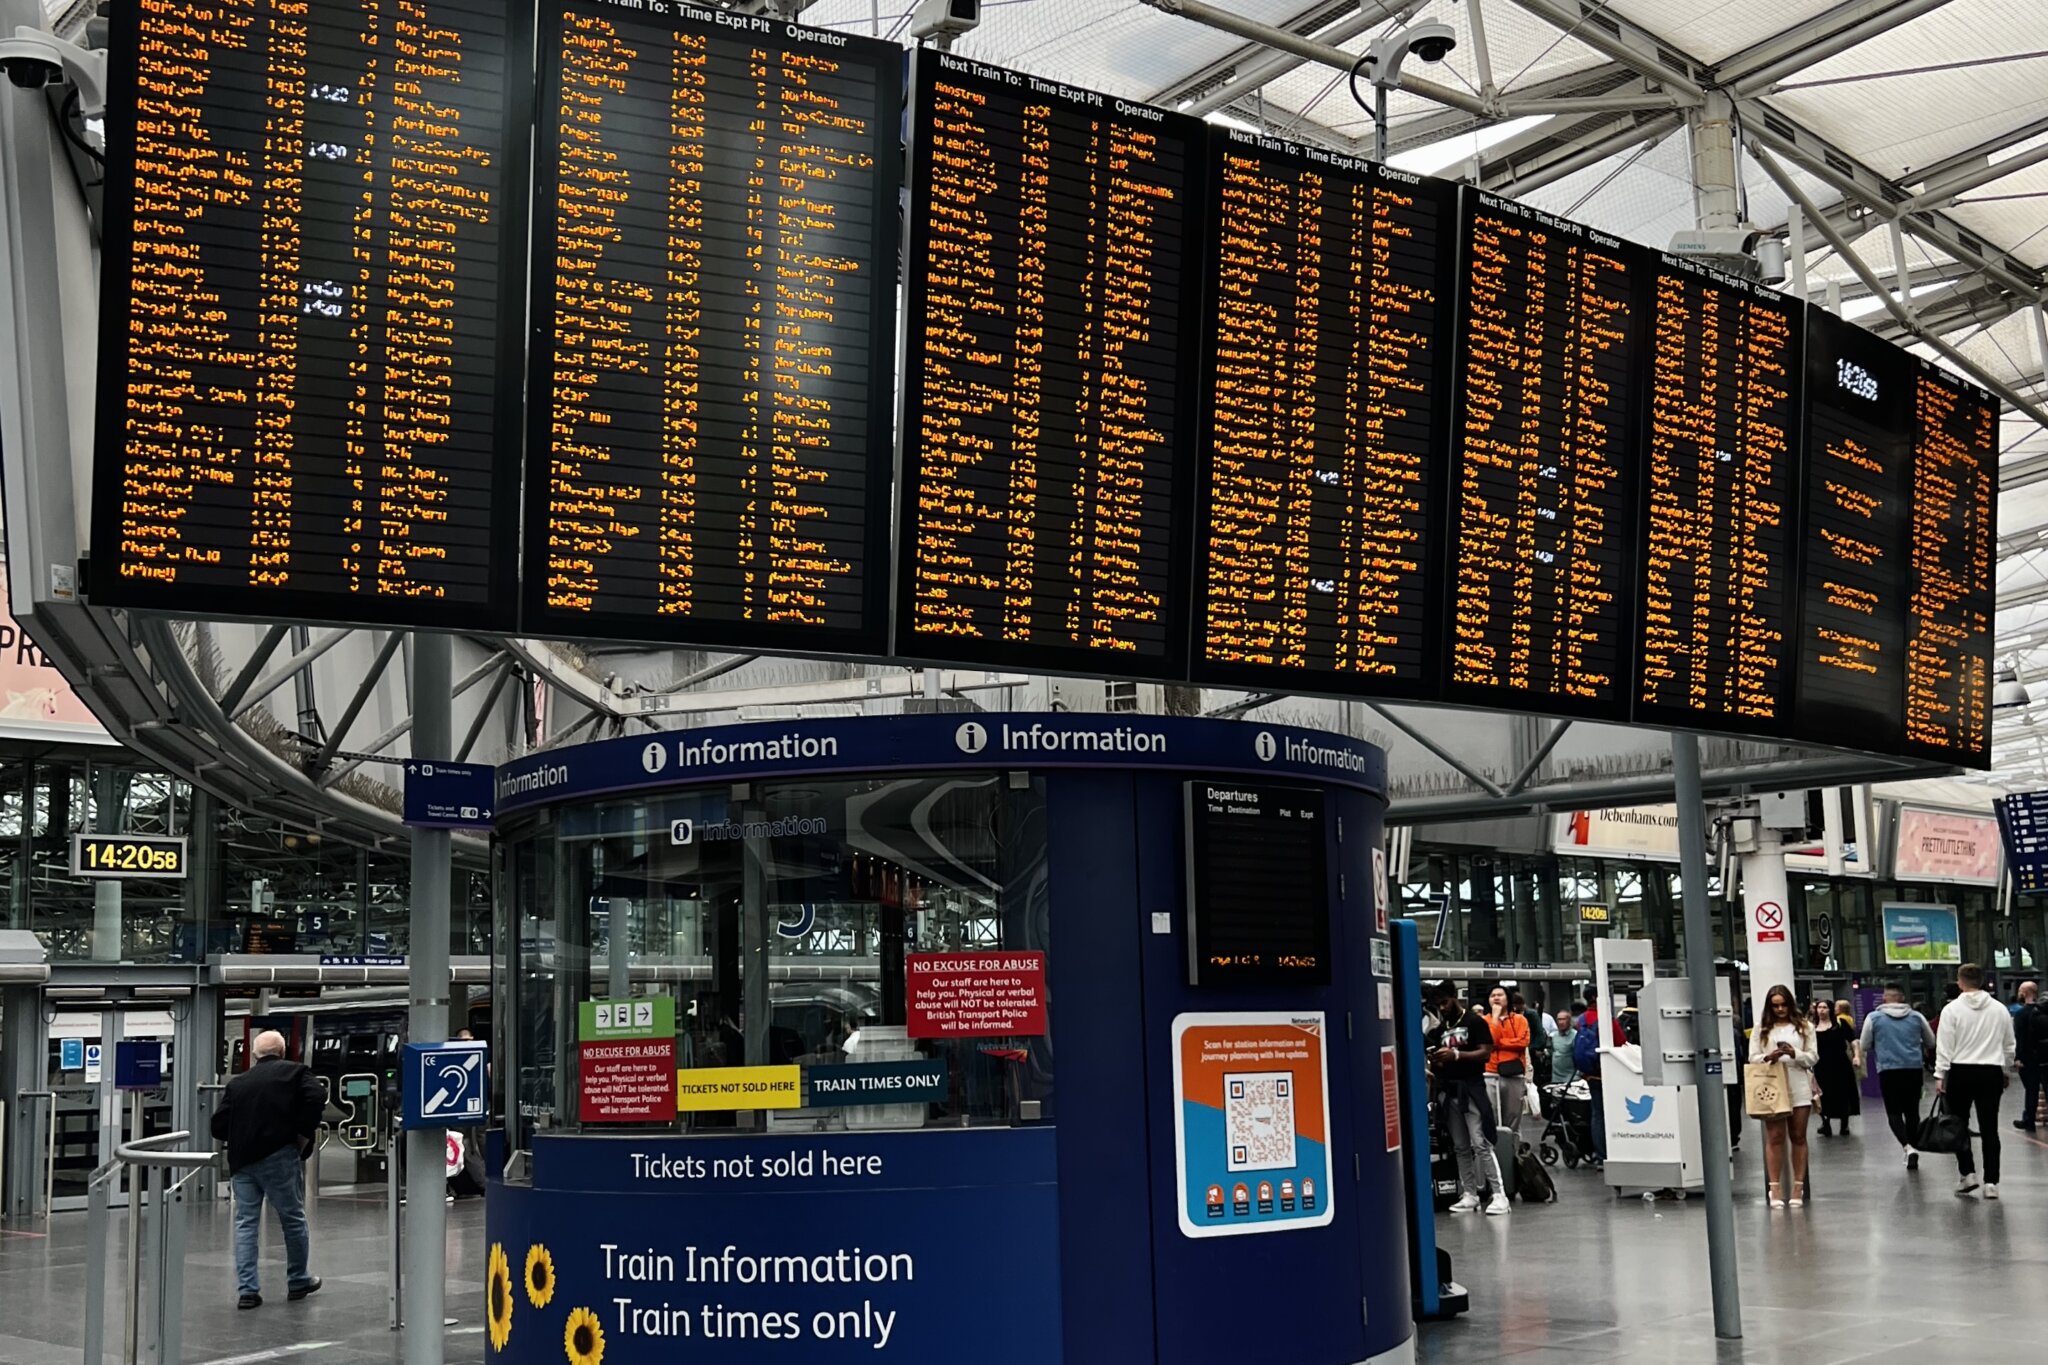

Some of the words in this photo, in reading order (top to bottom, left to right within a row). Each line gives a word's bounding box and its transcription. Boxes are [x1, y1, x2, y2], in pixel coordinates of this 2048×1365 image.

[677, 4, 712, 21] Time
[715, 12, 748, 29] Expt
[751, 14, 771, 33] Plt
[786, 25, 847, 47] Operator
[940, 54, 968, 72] Next
[970, 62, 1001, 81] Train
[1003, 71, 1022, 86] To:
[1028, 77, 1057, 95] Time
[1059, 86, 1085, 103] Expt
[1087, 92, 1103, 108] Plt
[1115, 100, 1164, 122] Operator
[1229, 129, 1253, 145] Next
[1255, 134, 1281, 151] Train
[1283, 141, 1299, 156] To:
[1304, 146, 1329, 163] Time
[1330, 154, 1353, 170] Expt
[1354, 159, 1368, 173] Plt
[1378, 165, 1420, 186] Operator
[1479, 193, 1497, 205] Next
[1499, 199, 1518, 214] Train
[1520, 206, 1531, 219] To:
[1535, 210, 1553, 226] Time
[1554, 217, 1571, 233] Expt
[1589, 230, 1620, 249] Operator
[1662, 252, 1677, 267] Next
[1678, 258, 1695, 272] Train
[1708, 268, 1724, 283] Time
[1754, 285, 1781, 302] Operator
[1002, 723, 1167, 753] Information
[678, 734, 838, 767] Information
[1285, 735, 1366, 773] Information
[1207, 787, 1259, 803] Departures
[1208, 804, 1223, 813] Time
[1227, 805, 1260, 815] Destination
[703, 815, 828, 842] Information
[313, 916, 322, 930] 5
[1429, 892, 1450, 948] 7
[907, 927, 914, 938] 6
[1819, 911, 1832, 955] 9
[913, 961, 931, 971] NO
[934, 960, 976, 971] EXCUSE
[980, 960, 1000, 970] FOR
[1003, 959, 1039, 970] ABUSE
[932, 978, 948, 987] Our
[951, 978, 971, 986] staff
[917, 990, 936, 1000] help
[938, 990, 957, 999] you.
[959, 988, 994, 999] Physical
[1007, 987, 1034, 996] verbal
[915, 1000, 942, 1009] abuse
[943, 1000, 959, 1008] will
[960, 999, 982, 1008] NOT
[983, 999, 995, 1007] be
[996, 998, 1038, 1007] tolerated.
[927, 1011, 955, 1020] British
[957, 1010, 1000, 1020] Transport
[1002, 1009, 1028, 1018] Police
[941, 1021, 957, 1030] will
[958, 1021, 969, 1029] be
[971, 1020, 1014, 1029] informed.
[584, 1048, 594, 1057] NO
[596, 1047, 623, 1056] EXCUSE
[625, 1046, 640, 1056] FOR
[643, 1045, 670, 1055] ABUSE
[1204, 1040, 1221, 1050] Scan
[1223, 1040, 1233, 1049] for
[1234, 1039, 1258, 1049] station
[1259, 1039, 1294, 1048] information
[1295, 1039, 1307, 1047] and
[1201, 1051, 1228, 1063] journey
[1229, 1051, 1260, 1062] planning
[1260, 1051, 1274, 1060] with
[1274, 1050, 1285, 1059] live
[1286, 1050, 1309, 1061] updates
[595, 1065, 605, 1073] Our
[607, 1064, 620, 1072] staff
[633, 1064, 647, 1072] here
[586, 1076, 597, 1085] help
[611, 1075, 636, 1084] Physical
[646, 1073, 667, 1082] verbal
[814, 1078, 856, 1092] TRAIN
[859, 1076, 902, 1090] TIMES
[905, 1074, 941, 1088] ONLY
[602, 1085, 612, 1093] will
[613, 1085, 627, 1093] NOT
[681, 1083, 719, 1095] TICKETS
[720, 1082, 741, 1093] NOT
[742, 1082, 767, 1093] SOLD
[770, 1081, 795, 1092] HERE
[591, 1096, 609, 1104] British
[611, 1095, 640, 1104] Transport
[642, 1095, 661, 1103] Police
[631, 1153, 706, 1178] Tickets
[713, 1154, 755, 1178] not
[761, 1150, 813, 1178] sold
[822, 1150, 882, 1176] here
[600, 1244, 674, 1281] Train
[686, 1245, 914, 1283] Information
[613, 1298, 690, 1337] Train
[701, 1304, 801, 1340] times
[812, 1300, 897, 1349] only
